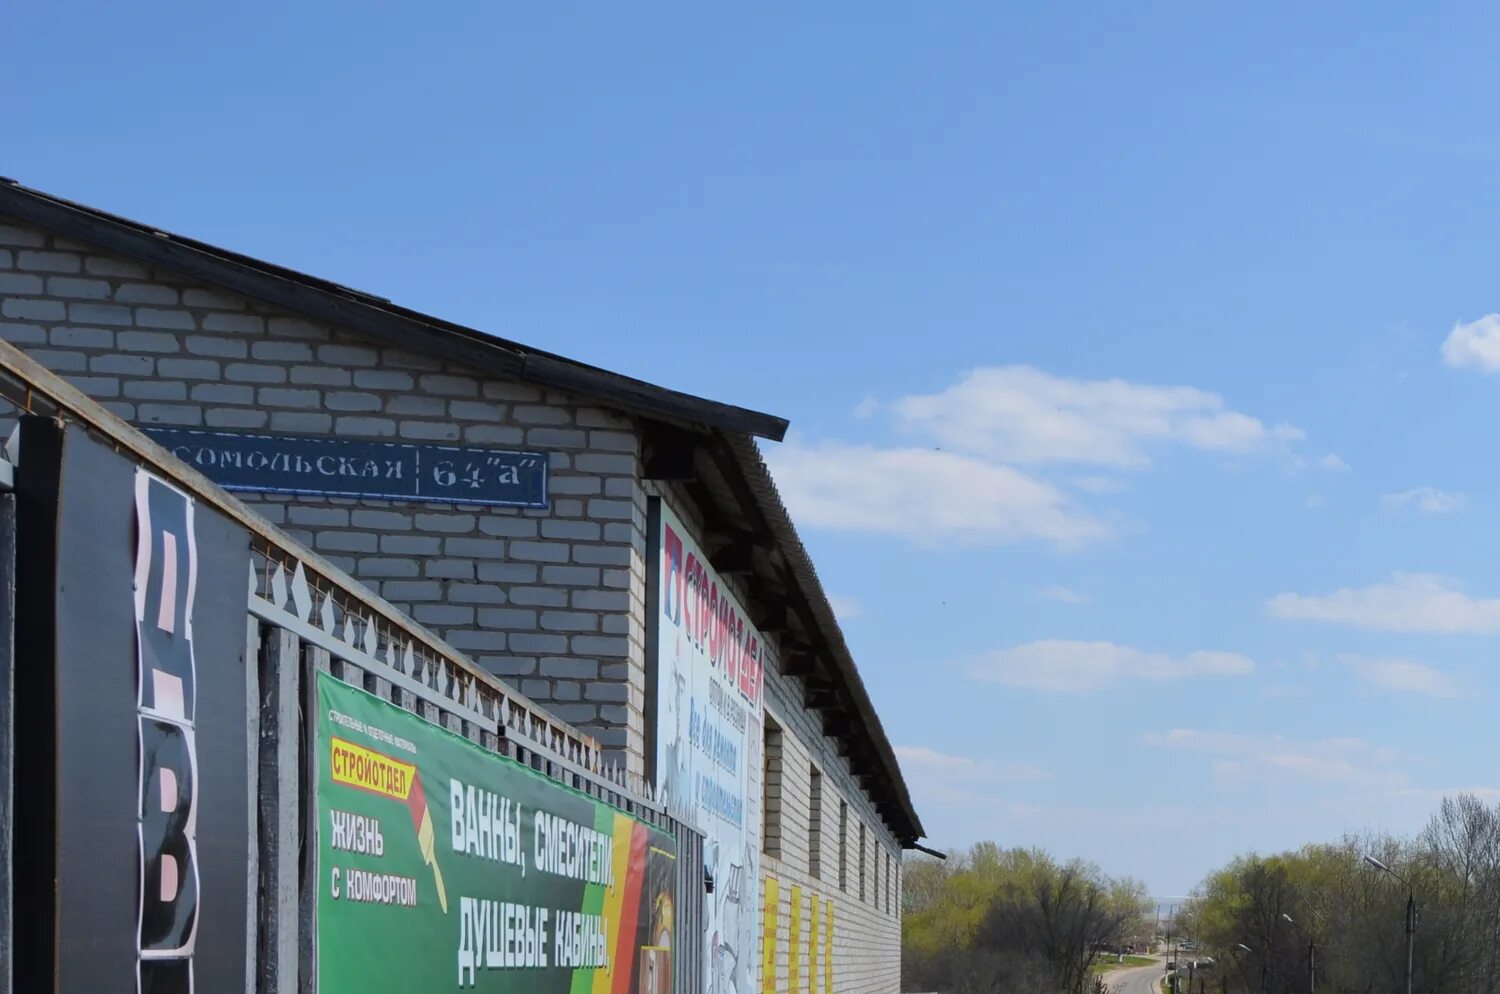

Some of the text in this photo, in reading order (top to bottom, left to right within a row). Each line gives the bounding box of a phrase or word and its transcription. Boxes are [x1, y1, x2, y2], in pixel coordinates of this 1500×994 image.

[333, 747, 406, 795] СТРОЙОТДЕЛ
[330, 809, 384, 856] ЖИЗНЬ
[451, 778, 615, 898] ВАННЫ, СМЕСИТЕЛИ,
[331, 867, 417, 906] С КОМФОРТОМ
[458, 896, 610, 986] ДУШЕВЫЕ КАБИНЫ,
